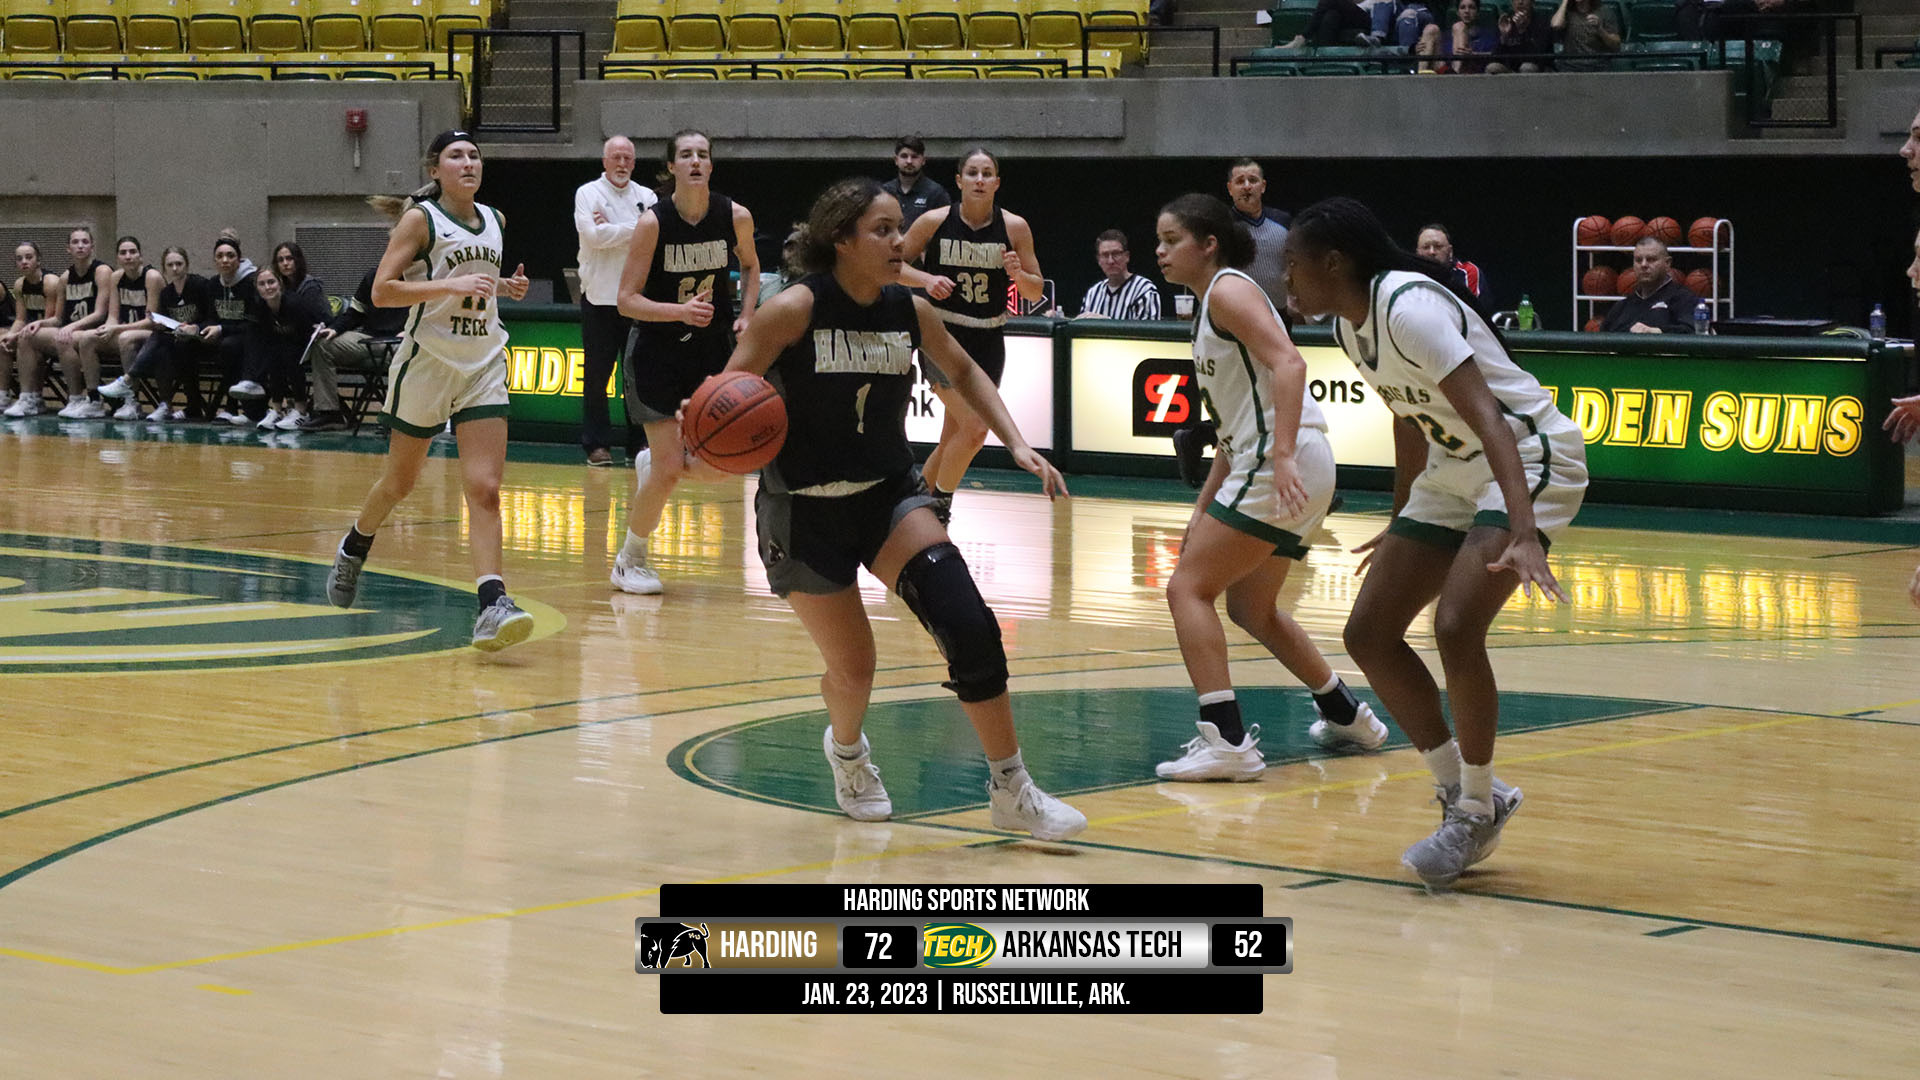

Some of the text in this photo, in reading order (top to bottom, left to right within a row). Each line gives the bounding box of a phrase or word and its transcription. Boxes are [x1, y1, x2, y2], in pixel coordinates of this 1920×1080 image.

[957, 272, 989, 303] 32
[450, 315, 488, 336] TECH
[814, 329, 912, 375] HARDING
[855, 383, 871, 434] 1
[1310, 379, 1364, 403] ons
[1700, 391, 1864, 456] SUNS
